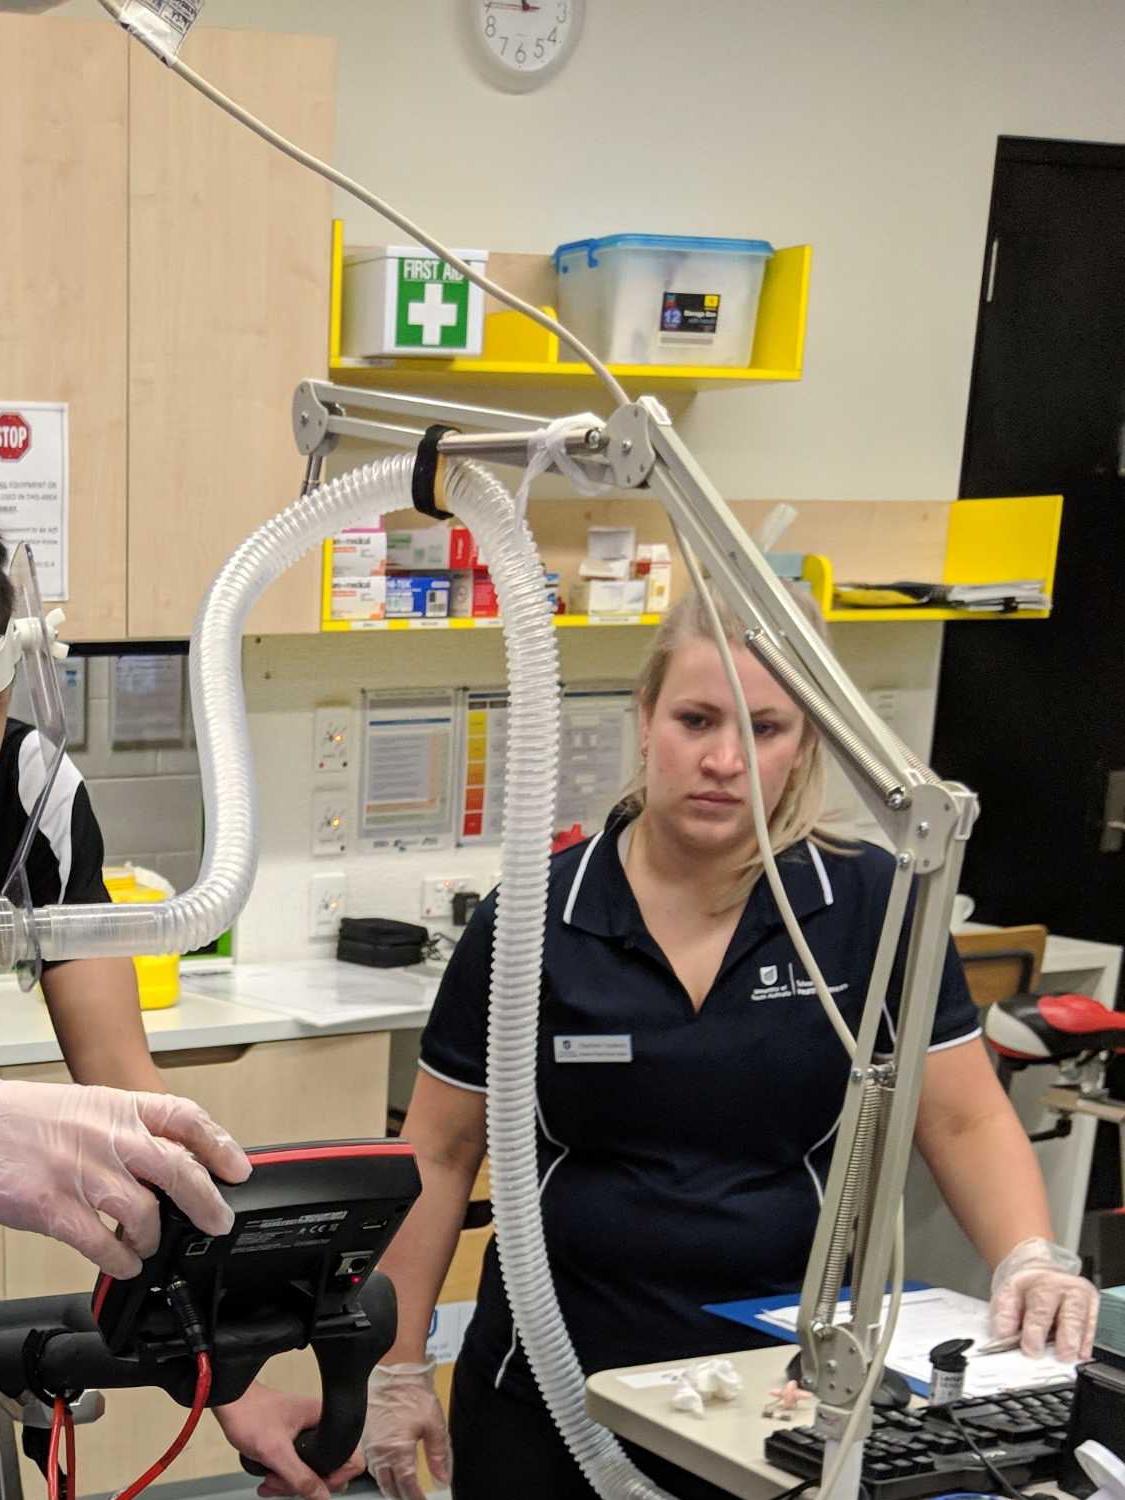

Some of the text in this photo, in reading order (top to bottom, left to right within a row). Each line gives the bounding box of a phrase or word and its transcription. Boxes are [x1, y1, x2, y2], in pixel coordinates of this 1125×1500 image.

[556, 2, 567, 23] 3
[484, 15, 496, 37] 8
[547, 26, 557, 46] 4
[498, 36, 509, 56] 7
[515, 42, 527, 63] 6
[534, 38, 544, 58] 5
[403, 259, 439, 280] FIRST
